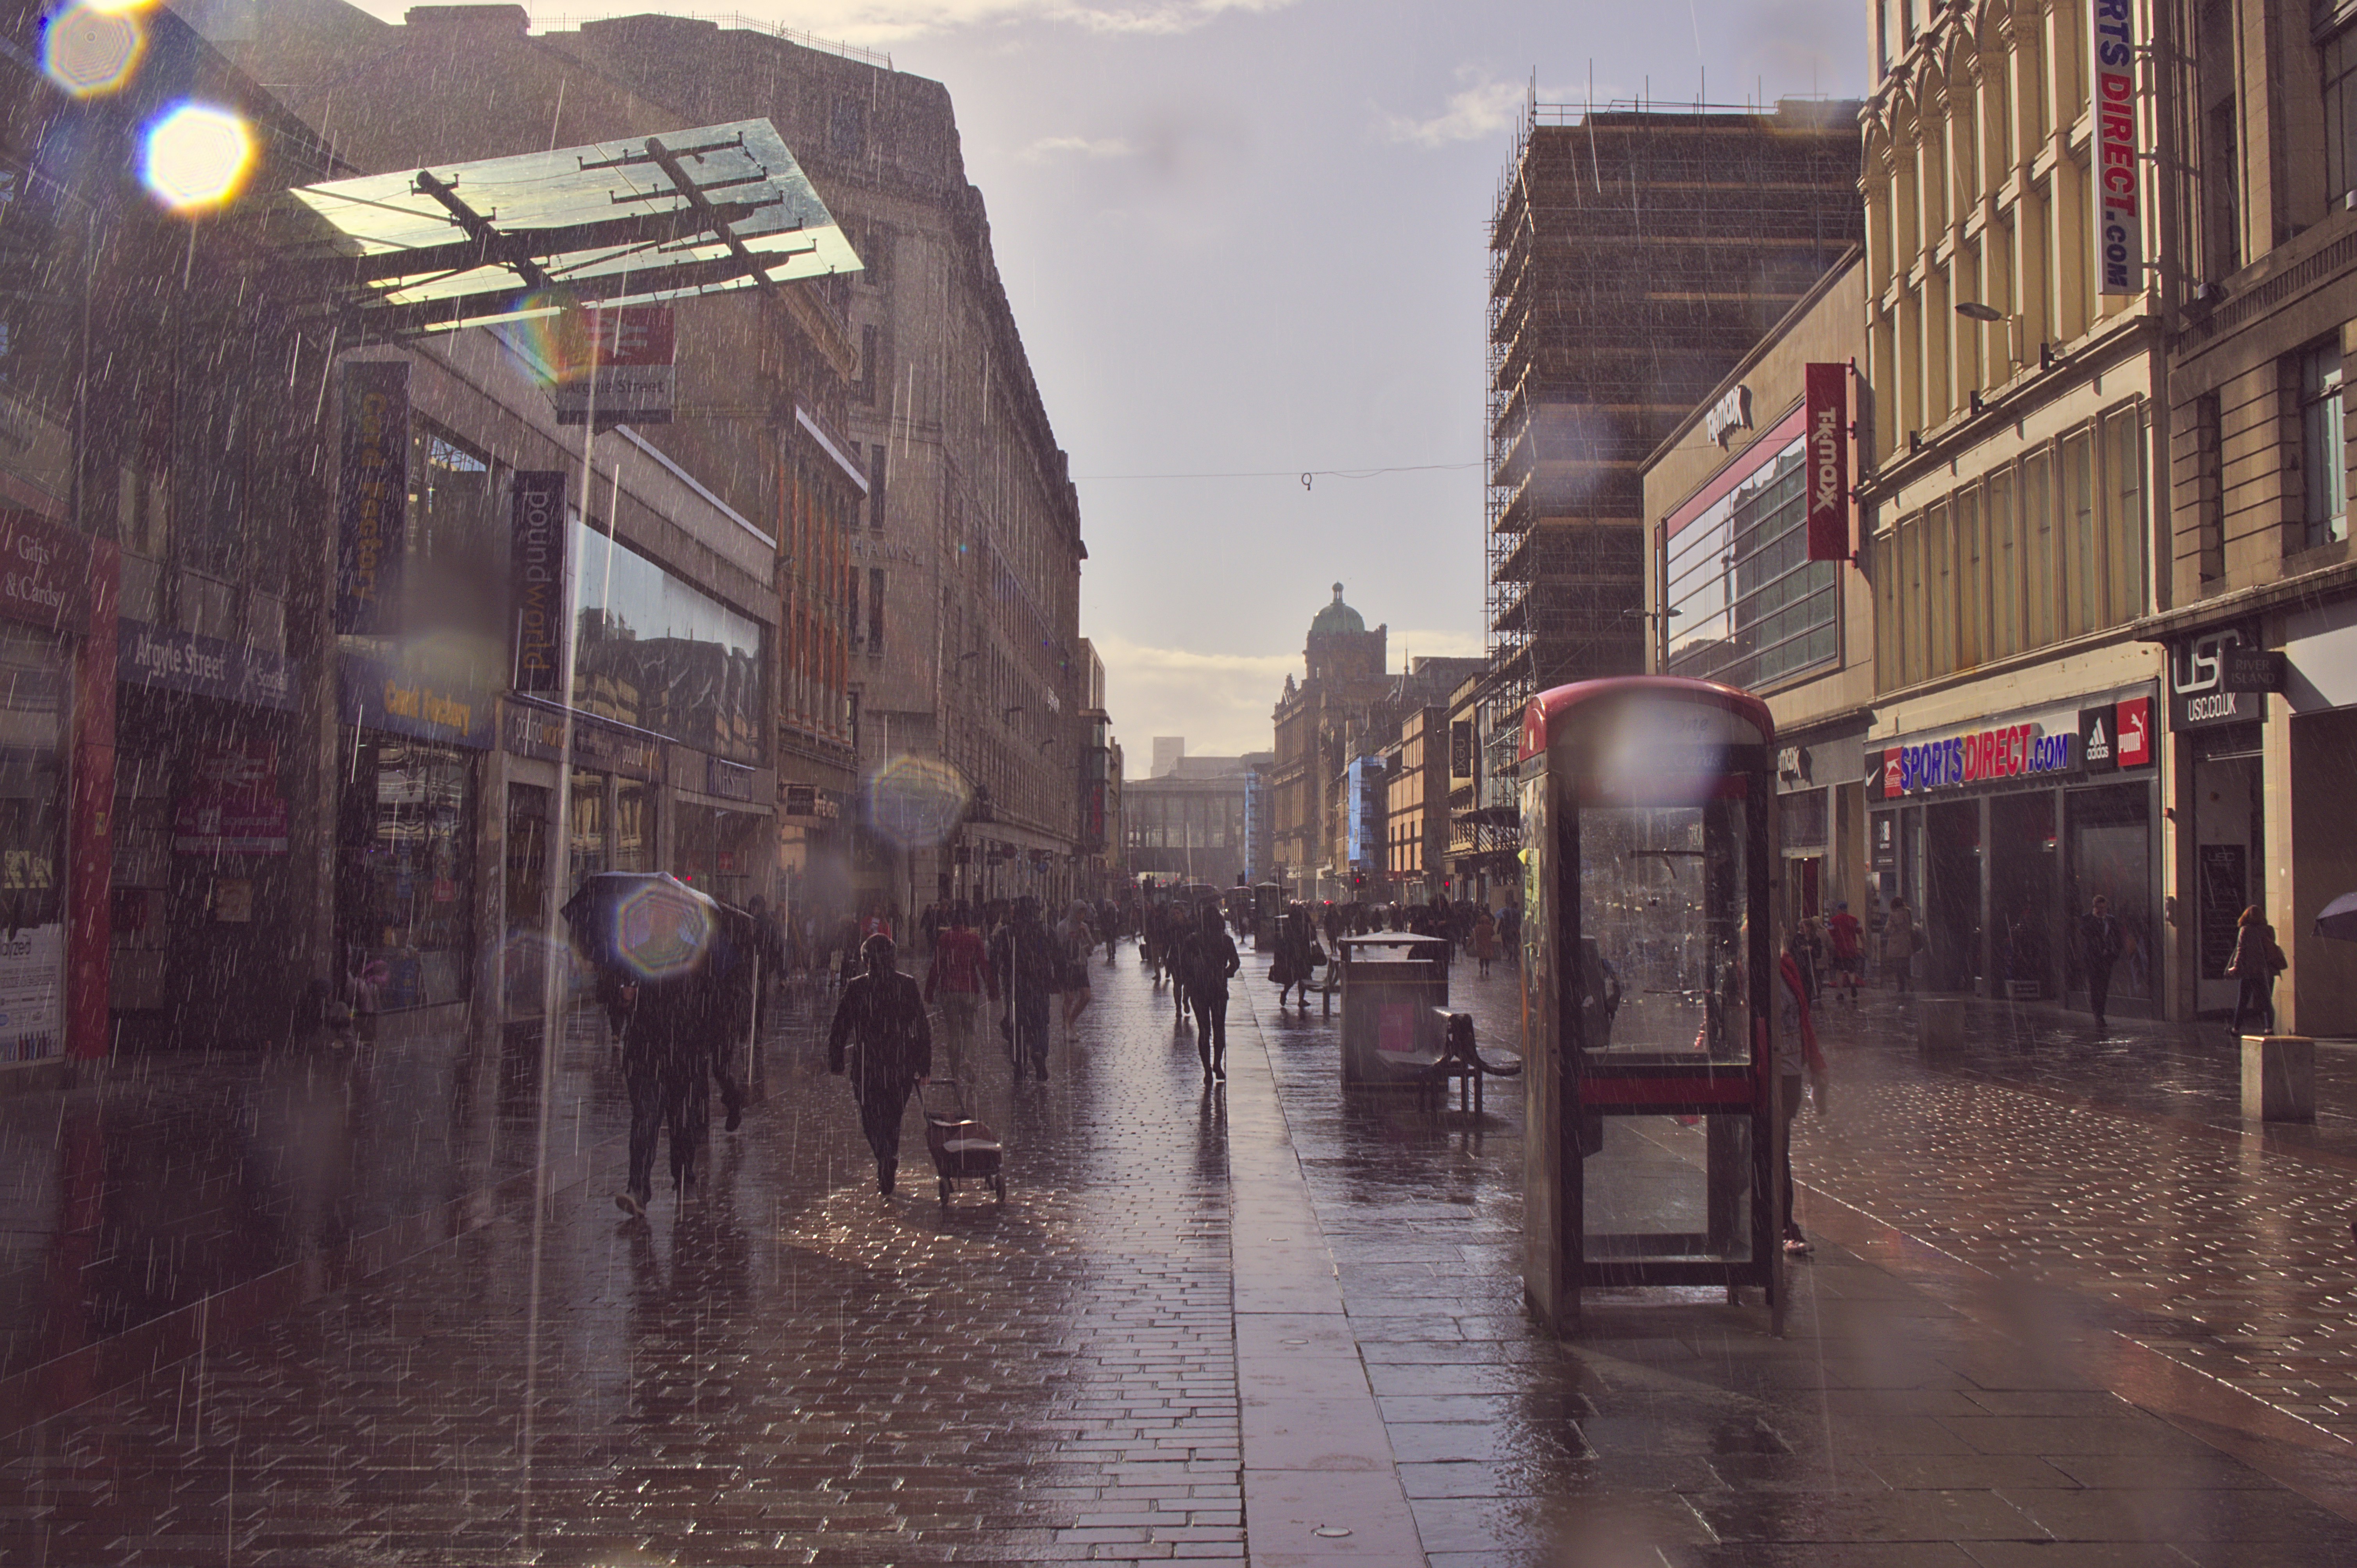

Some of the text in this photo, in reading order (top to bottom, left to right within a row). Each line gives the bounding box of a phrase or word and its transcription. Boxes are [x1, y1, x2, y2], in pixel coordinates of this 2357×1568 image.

[566, 380, 665, 396] Argyle Street
[351, 392, 388, 602] Card Factory
[18, 534, 50, 565] Gifts
[5, 571, 61, 607] & Cards
[522, 491, 553, 669] poundworld
[134, 633, 225, 681] Argyle Street
[2235, 659, 2269, 671] RIVER
[2231, 672, 2275, 684] ISLAND
[384, 679, 471, 737] Card Factory
[2188, 693, 2236, 721] USC.CO.UK
[1455, 738, 1467, 774] next
[2087, 745, 2109, 761] adidas
[2118, 730, 2141, 754] PUMA
